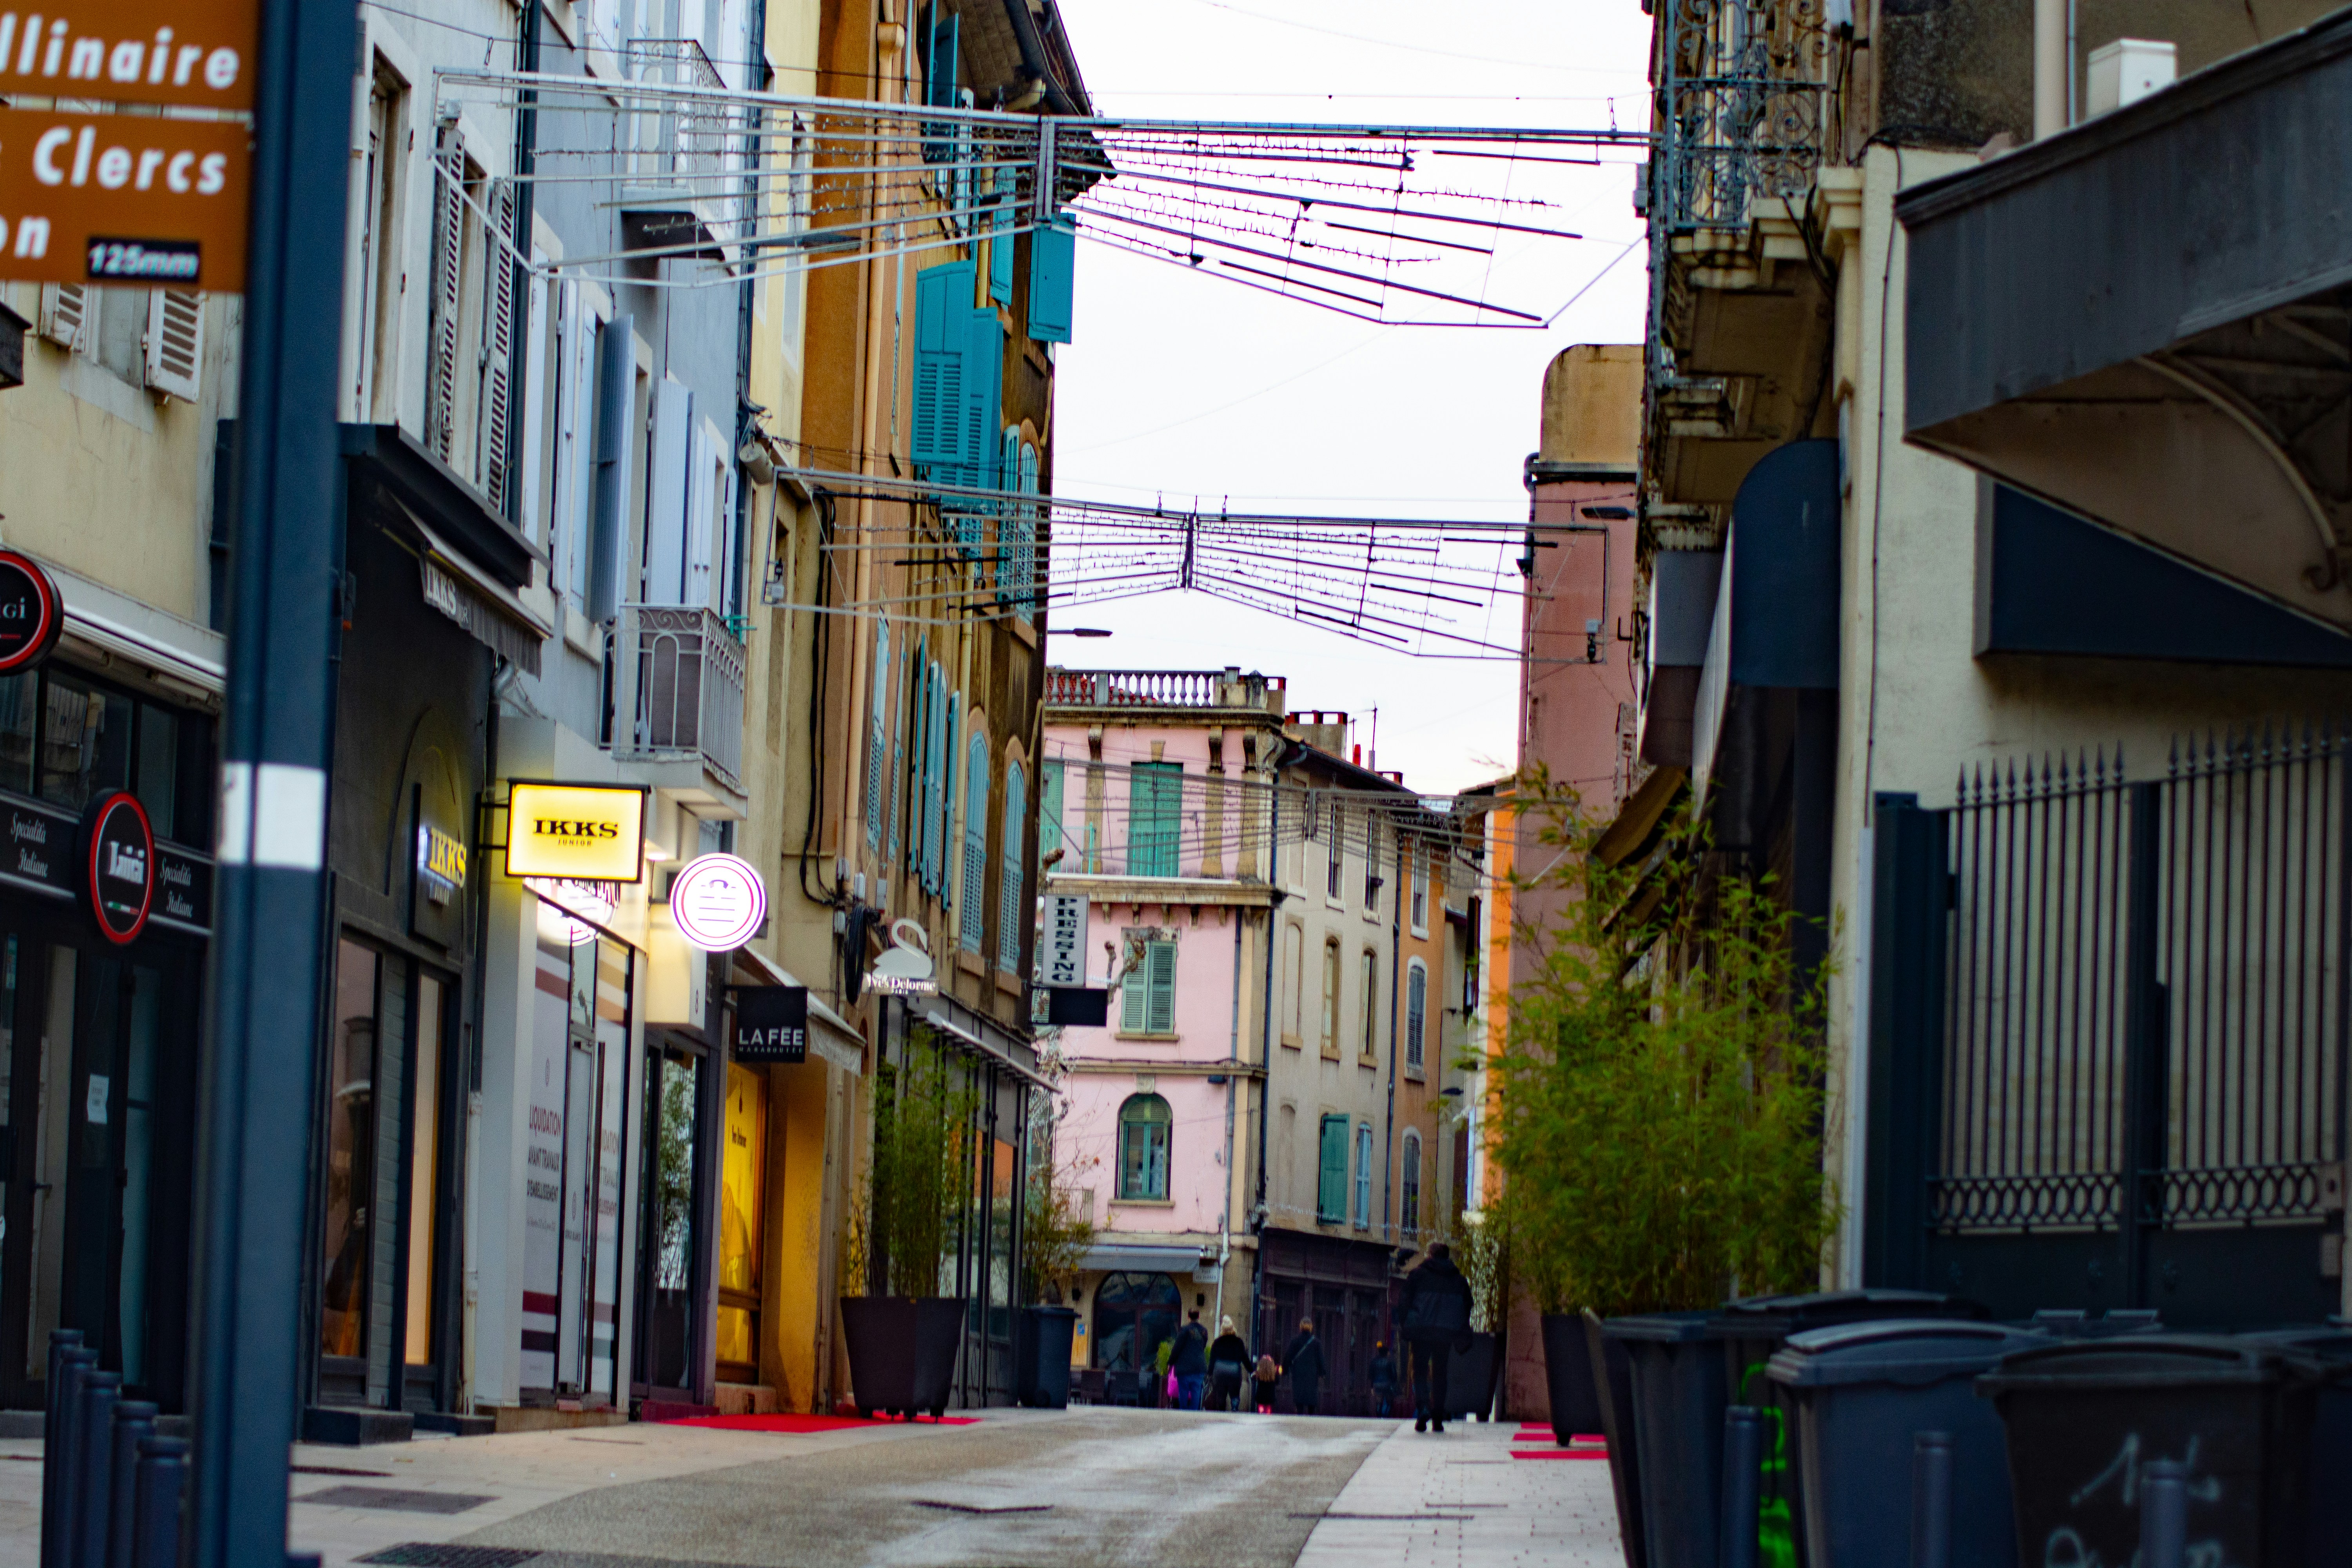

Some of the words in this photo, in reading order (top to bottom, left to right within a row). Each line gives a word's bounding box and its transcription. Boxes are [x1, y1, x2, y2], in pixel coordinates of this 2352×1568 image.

[33, 125, 227, 194] Clercs
[0, 214, 51, 259] n
[89, 243, 199, 278] 125mm
[426, 561, 456, 615] IKKS
[533, 819, 618, 839] IKKS
[18, 848, 48, 878] Italiane
[429, 827, 467, 888] IKKS
[166, 890, 192, 918] Italiane
[1052, 897, 1079, 982] PRESSING
[891, 976, 936, 991] Delorme
[739, 1027, 764, 1045] LA
[529, 1103, 561, 1137] LIQUIDATION
[528, 1145, 542, 1169] AVANT
[542, 1147, 560, 1172] TRAVAUX
